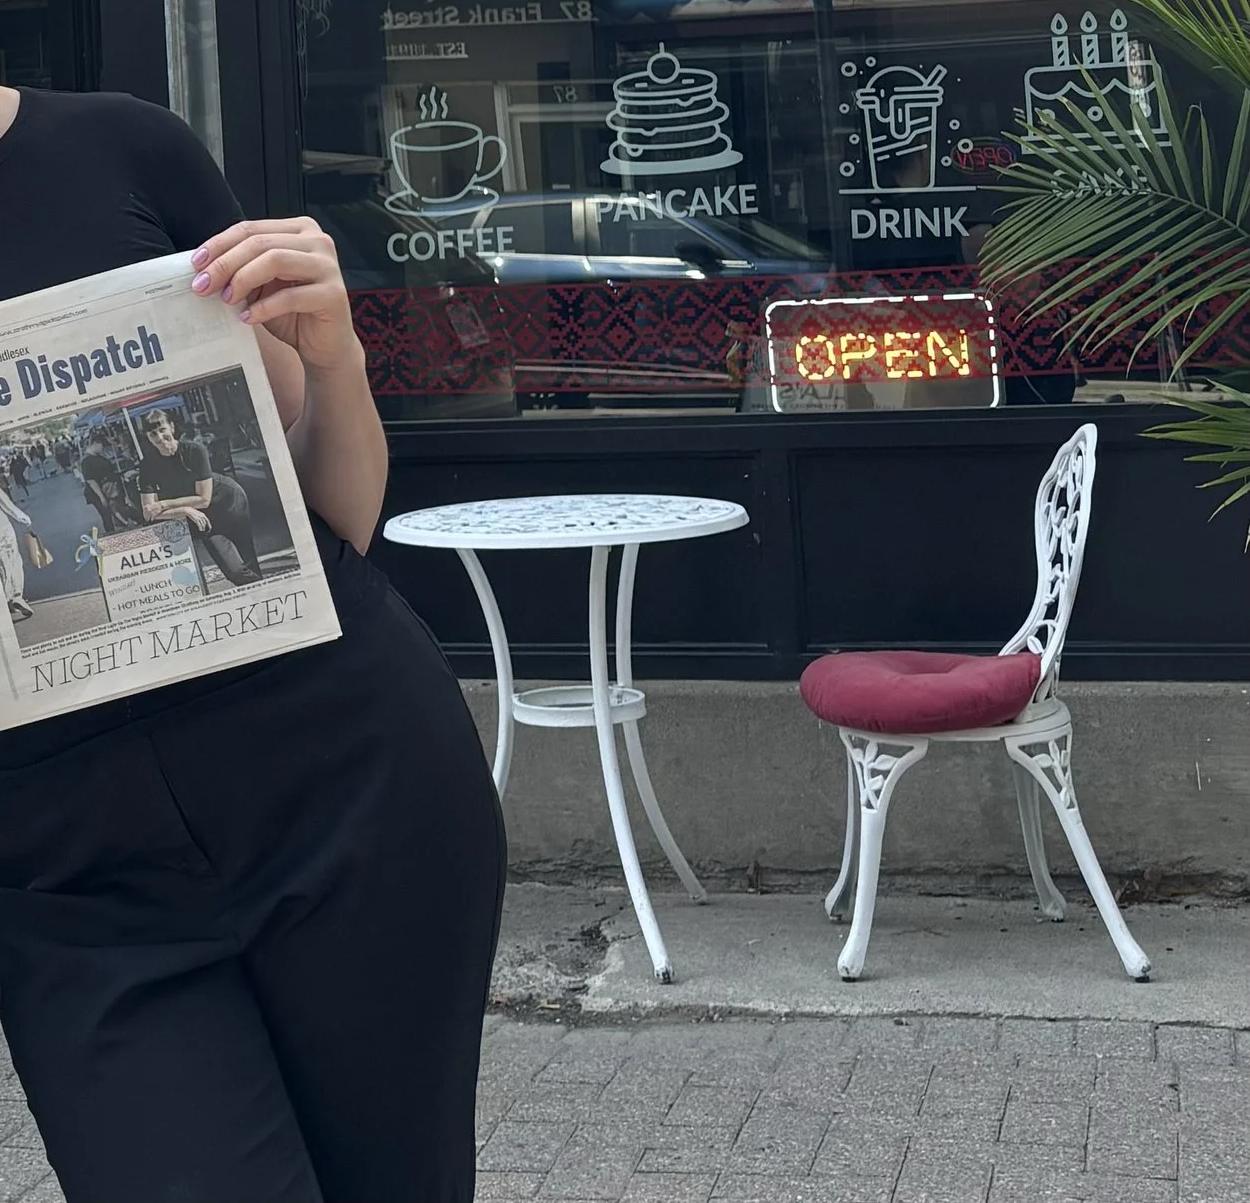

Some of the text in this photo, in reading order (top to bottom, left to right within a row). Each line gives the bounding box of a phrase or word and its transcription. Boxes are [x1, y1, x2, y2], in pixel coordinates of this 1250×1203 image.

[593, 184, 759, 223] PANCAKE
[851, 206, 970, 240] DRINK
[386, 225, 514, 263] COFFEE
[15, 325, 164, 400] Dispatch
[795, 329, 970, 381] OPEN
[120, 544, 173, 570] ALLA'S
[117, 599, 138, 612] HOT
[139, 593, 170, 606] MEALS
[171, 589, 184, 599] TO
[185, 584, 200, 595] GO
[139, 579, 173, 593] LUNCH
[31, 635, 142, 693] NIGHT
[149, 590, 307, 659] MARKET
